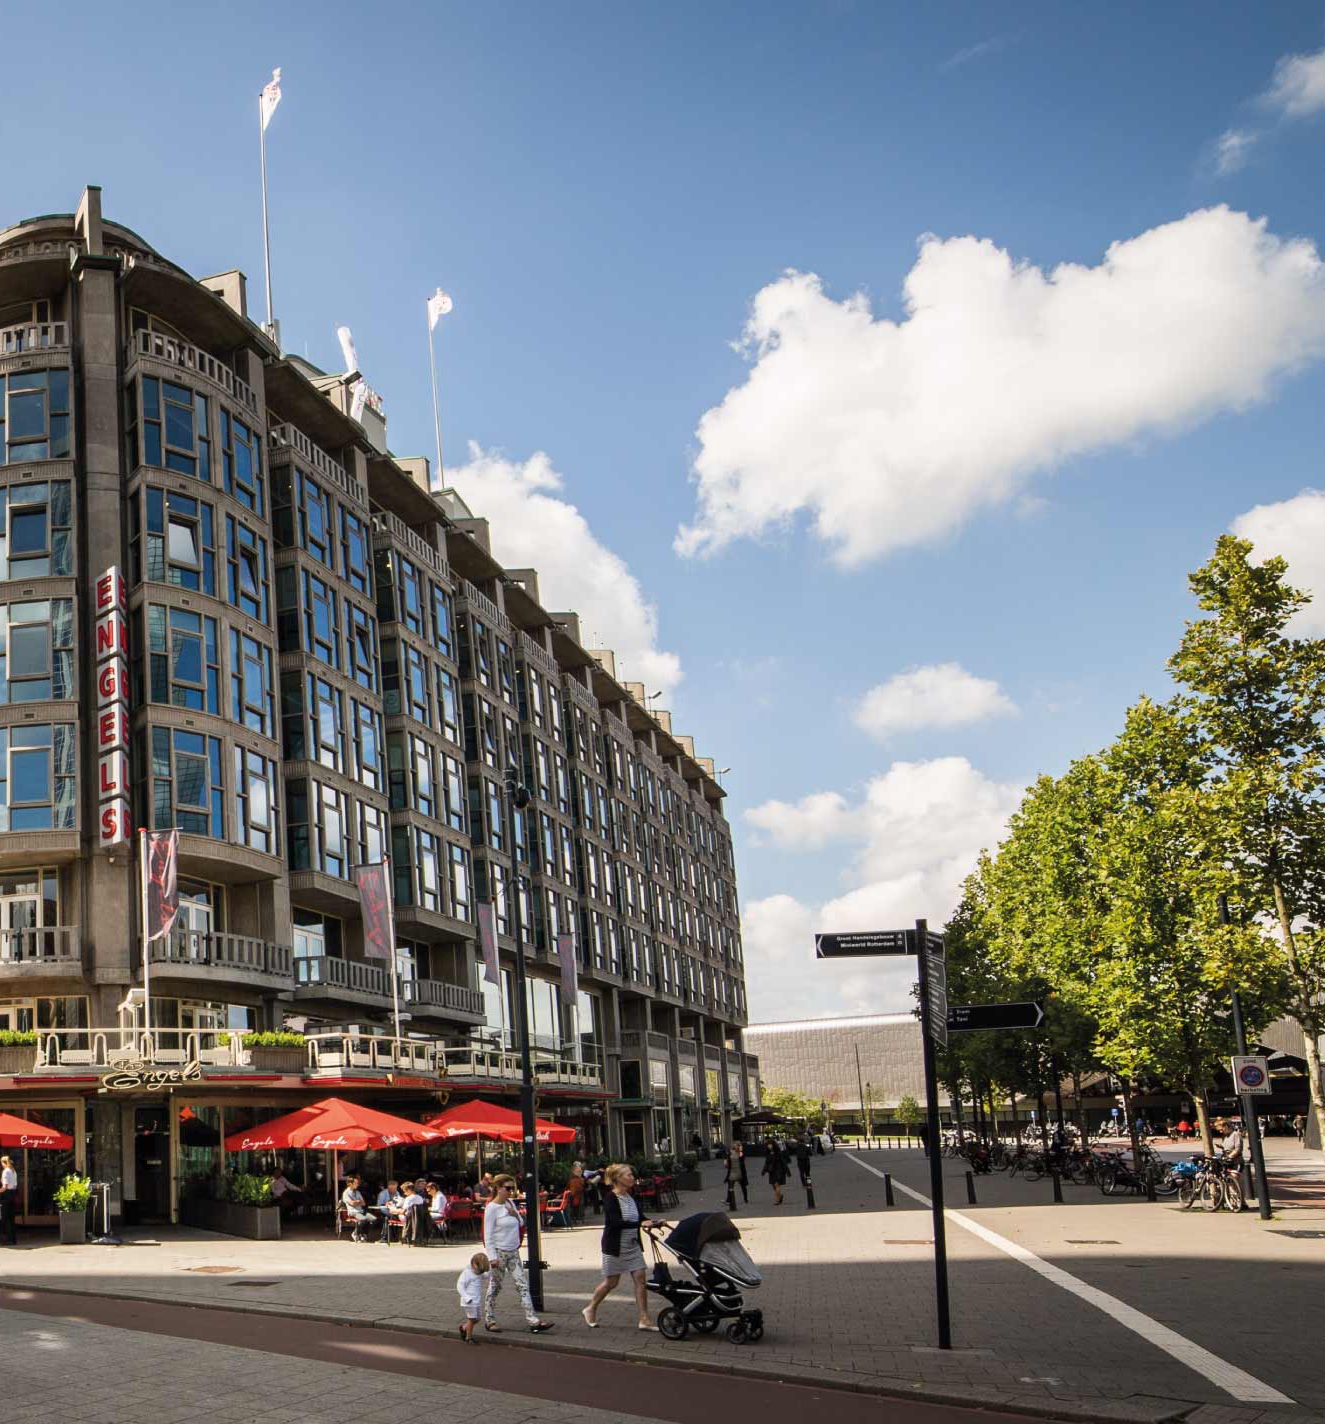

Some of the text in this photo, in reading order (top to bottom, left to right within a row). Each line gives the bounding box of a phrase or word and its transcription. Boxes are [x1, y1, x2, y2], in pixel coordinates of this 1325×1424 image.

[96, 575, 117, 840] ENGELS
[102, 1060, 202, 1091] Engels
[20, 1135, 55, 1147] Engels
[242, 1136, 275, 1149] Engels
[312, 1135, 348, 1148] Engels
